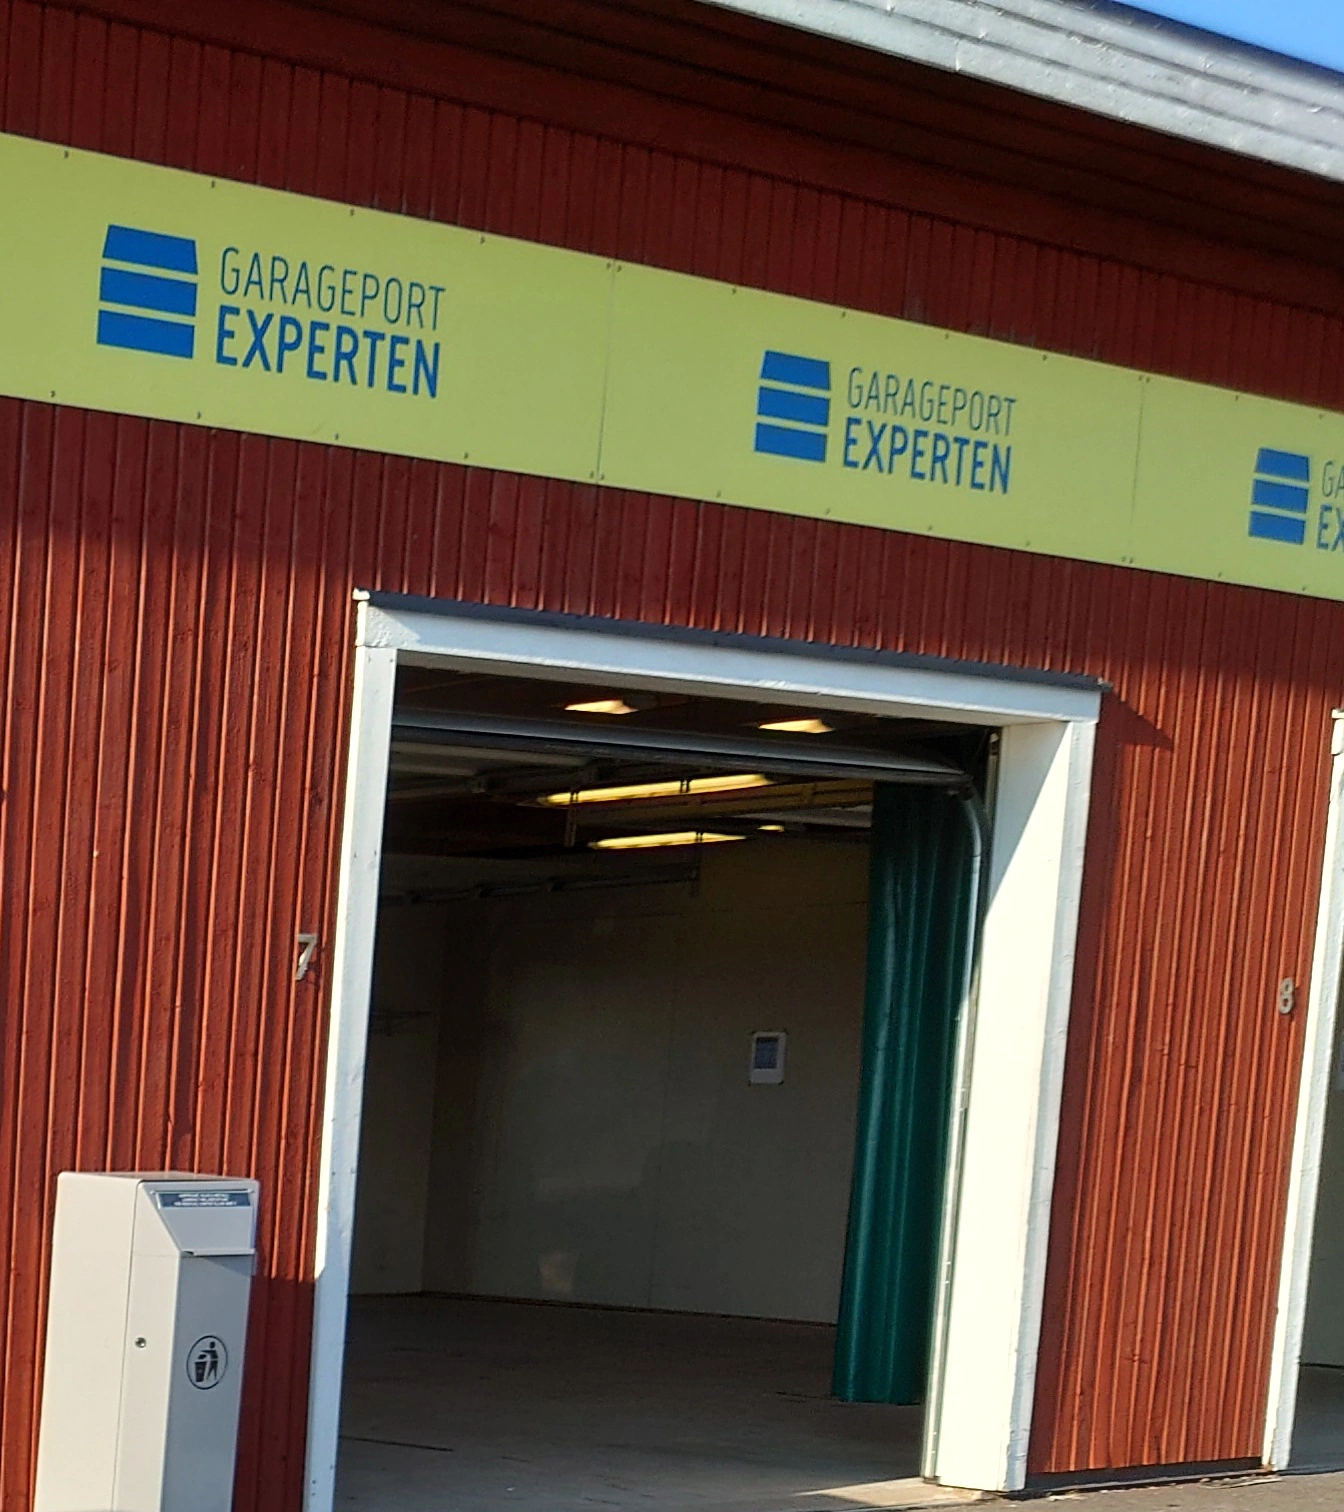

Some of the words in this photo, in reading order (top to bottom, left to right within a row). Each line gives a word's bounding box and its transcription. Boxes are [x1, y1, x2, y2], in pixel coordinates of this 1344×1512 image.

[220, 246, 446, 331] GARAGEPORT
[215, 304, 441, 399] EXPERTEN
[847, 365, 1017, 437] GARAGEPORT
[842, 416, 1013, 495] EXPERTEN
[294, 933, 318, 980] 7
[1279, 976, 1294, 1014] 8
